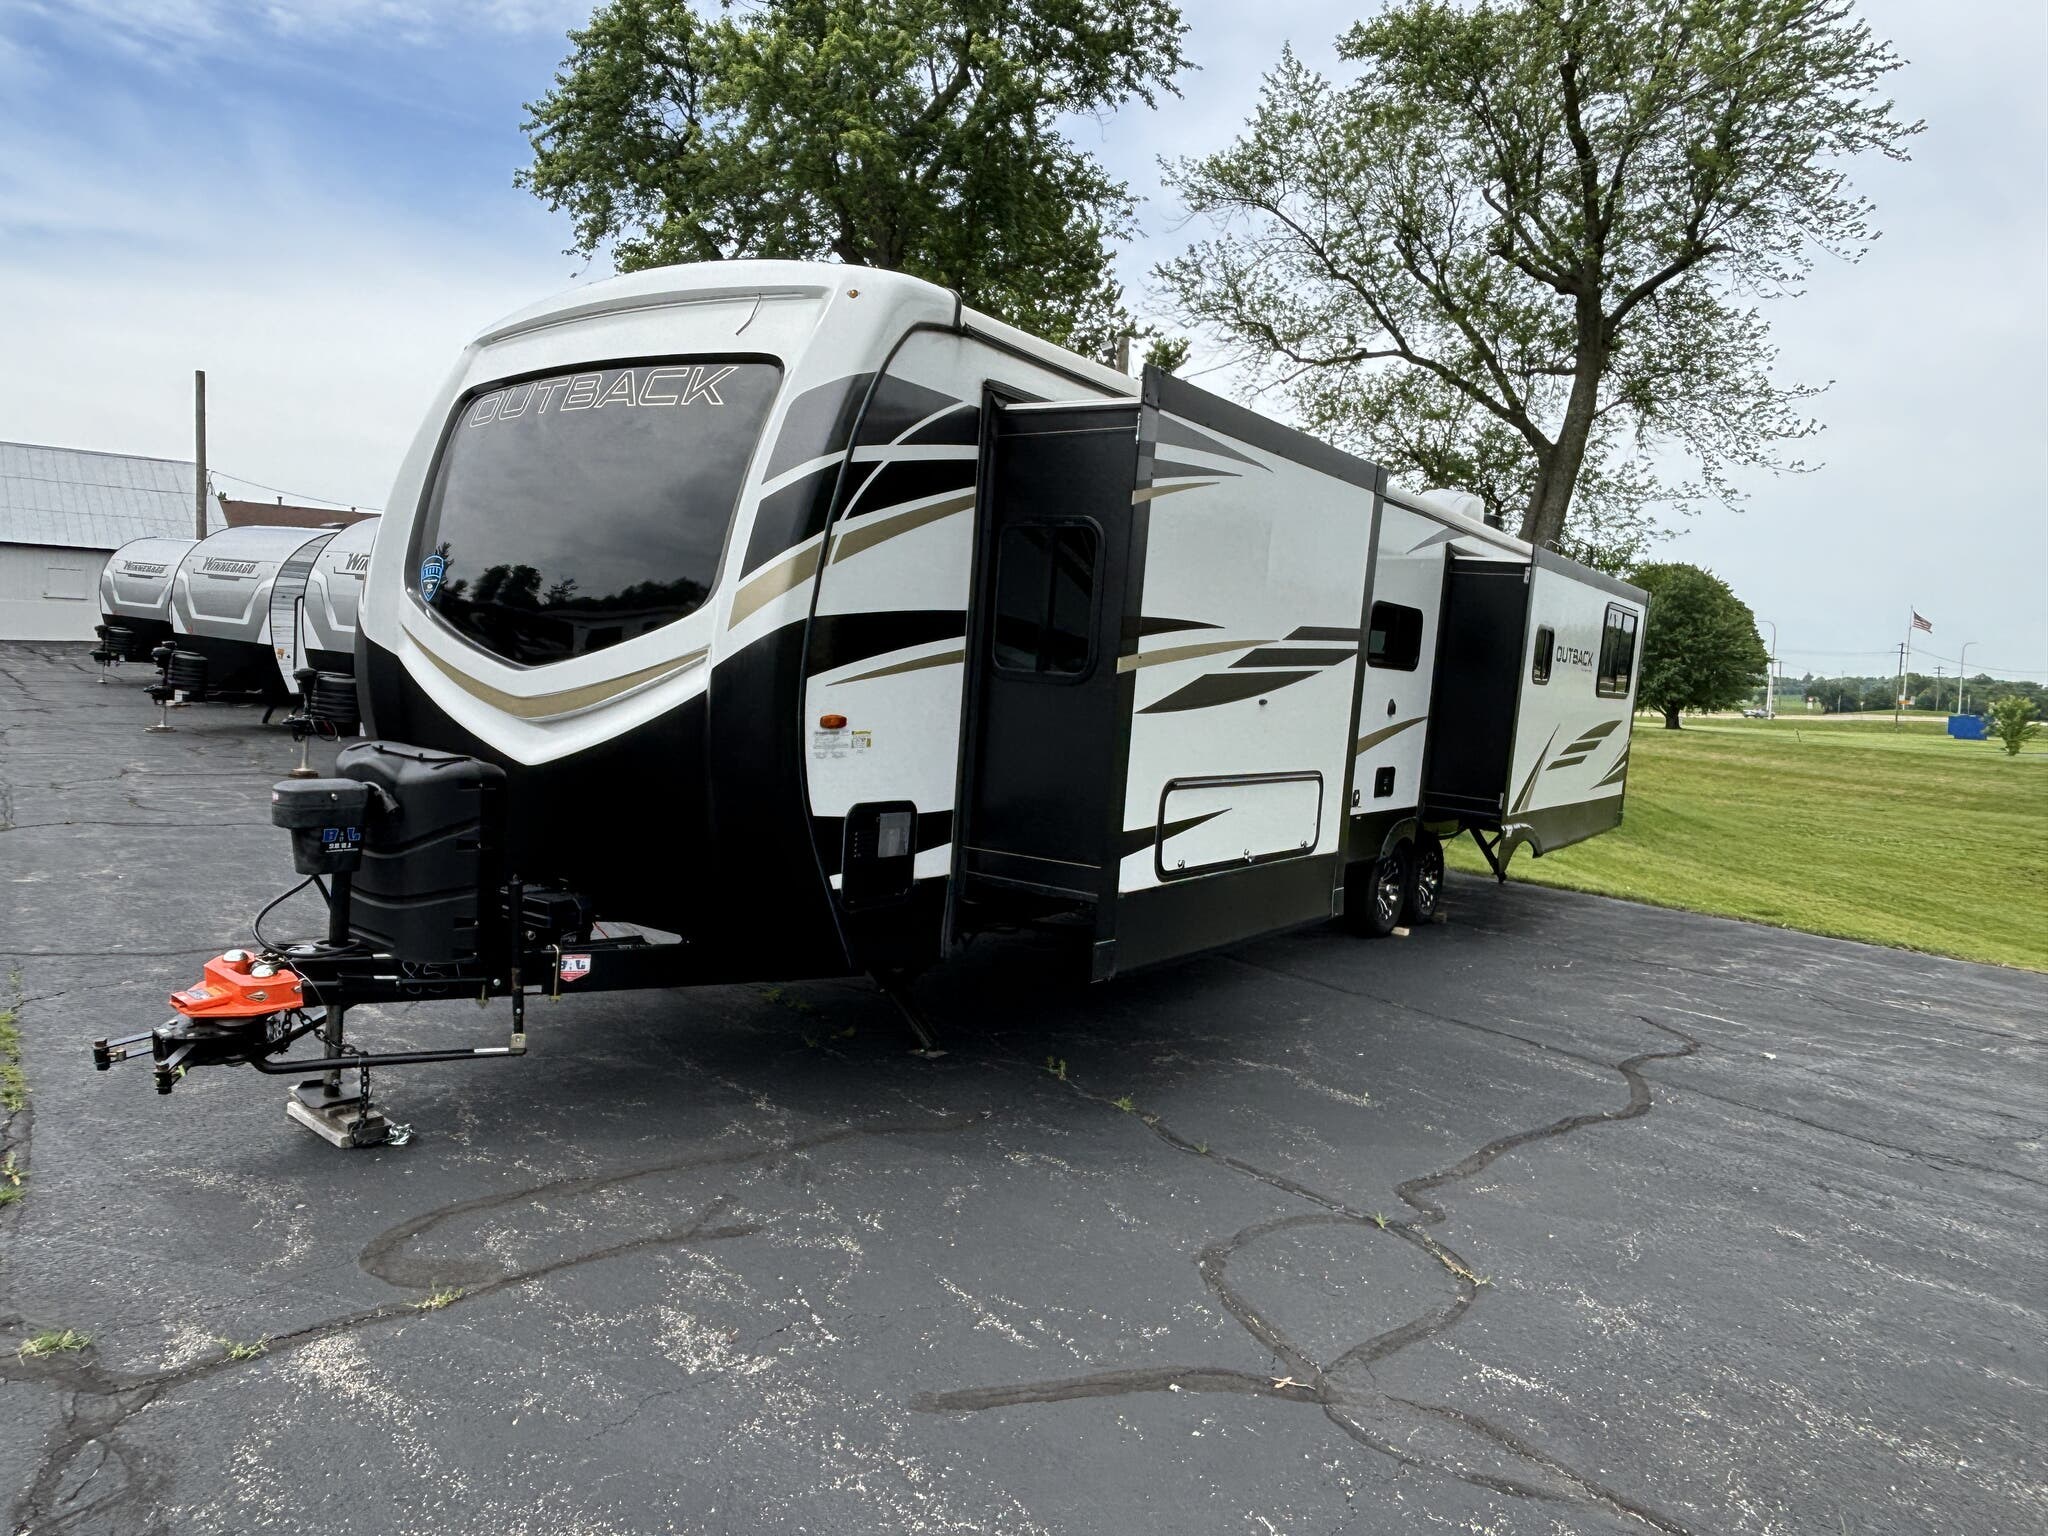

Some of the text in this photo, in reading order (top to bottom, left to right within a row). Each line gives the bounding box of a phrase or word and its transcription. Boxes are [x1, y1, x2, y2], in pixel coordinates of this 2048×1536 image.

[468, 365, 740, 428] OUTBACK
[203, 556, 257, 575] WINNEBAGO
[1556, 645, 1594, 667] OUTBACK
